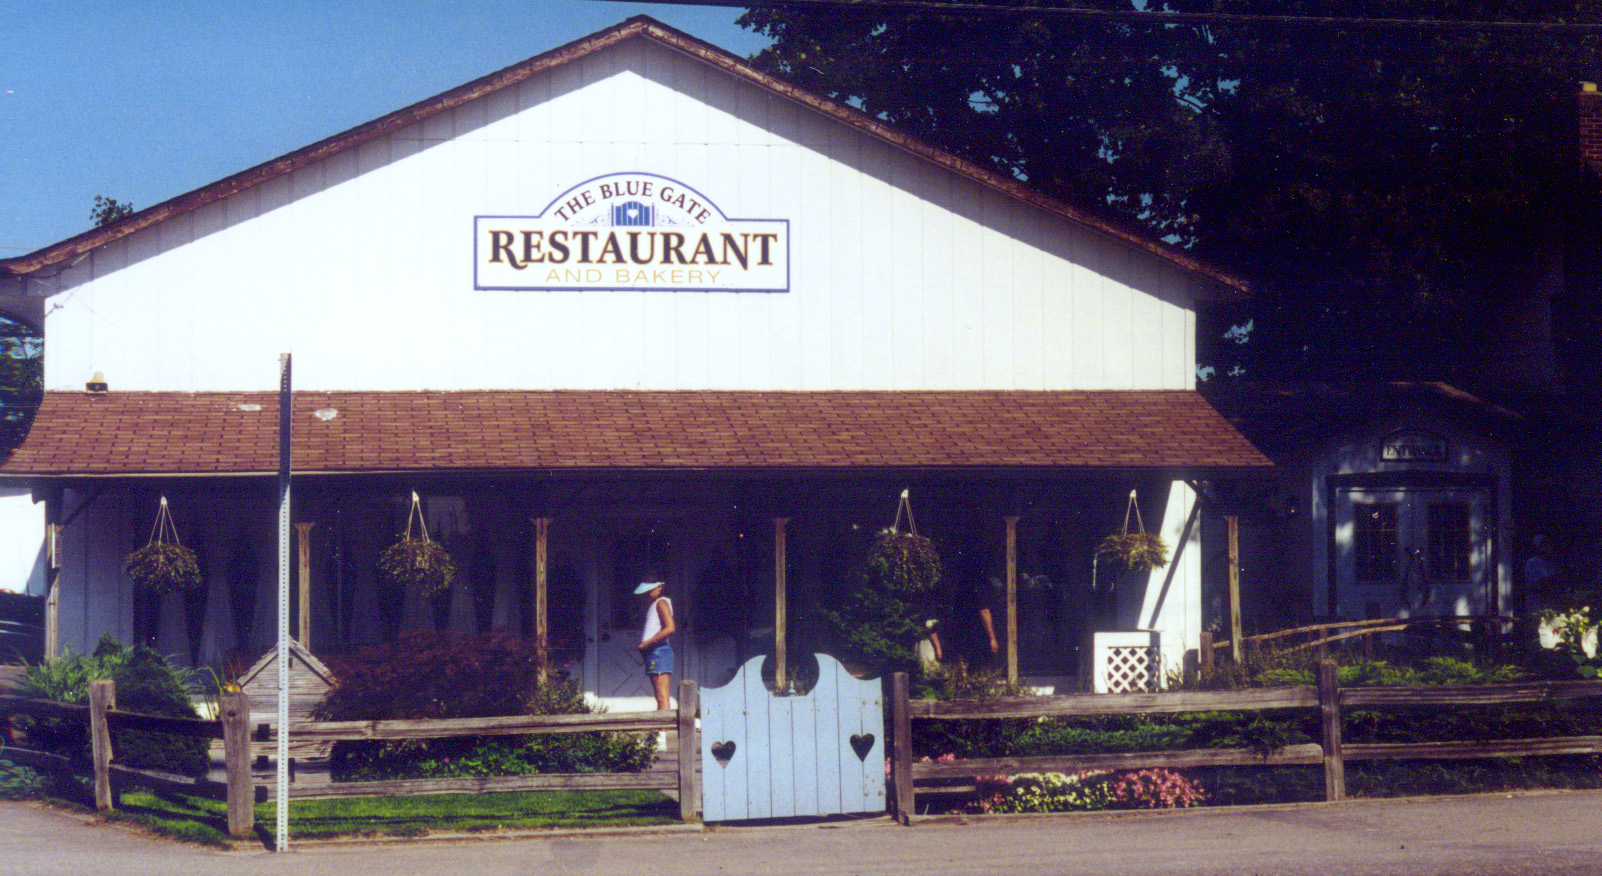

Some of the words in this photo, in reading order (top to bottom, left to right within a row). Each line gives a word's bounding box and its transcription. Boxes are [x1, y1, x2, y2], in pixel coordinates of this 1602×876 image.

[554, 190, 596, 222] THE
[599, 181, 653, 200] BLUE
[659, 186, 711, 224] GATE
[488, 229, 778, 271] RESTAURANT
[545, 269, 603, 283] AND
[616, 269, 721, 284] BAKERY
